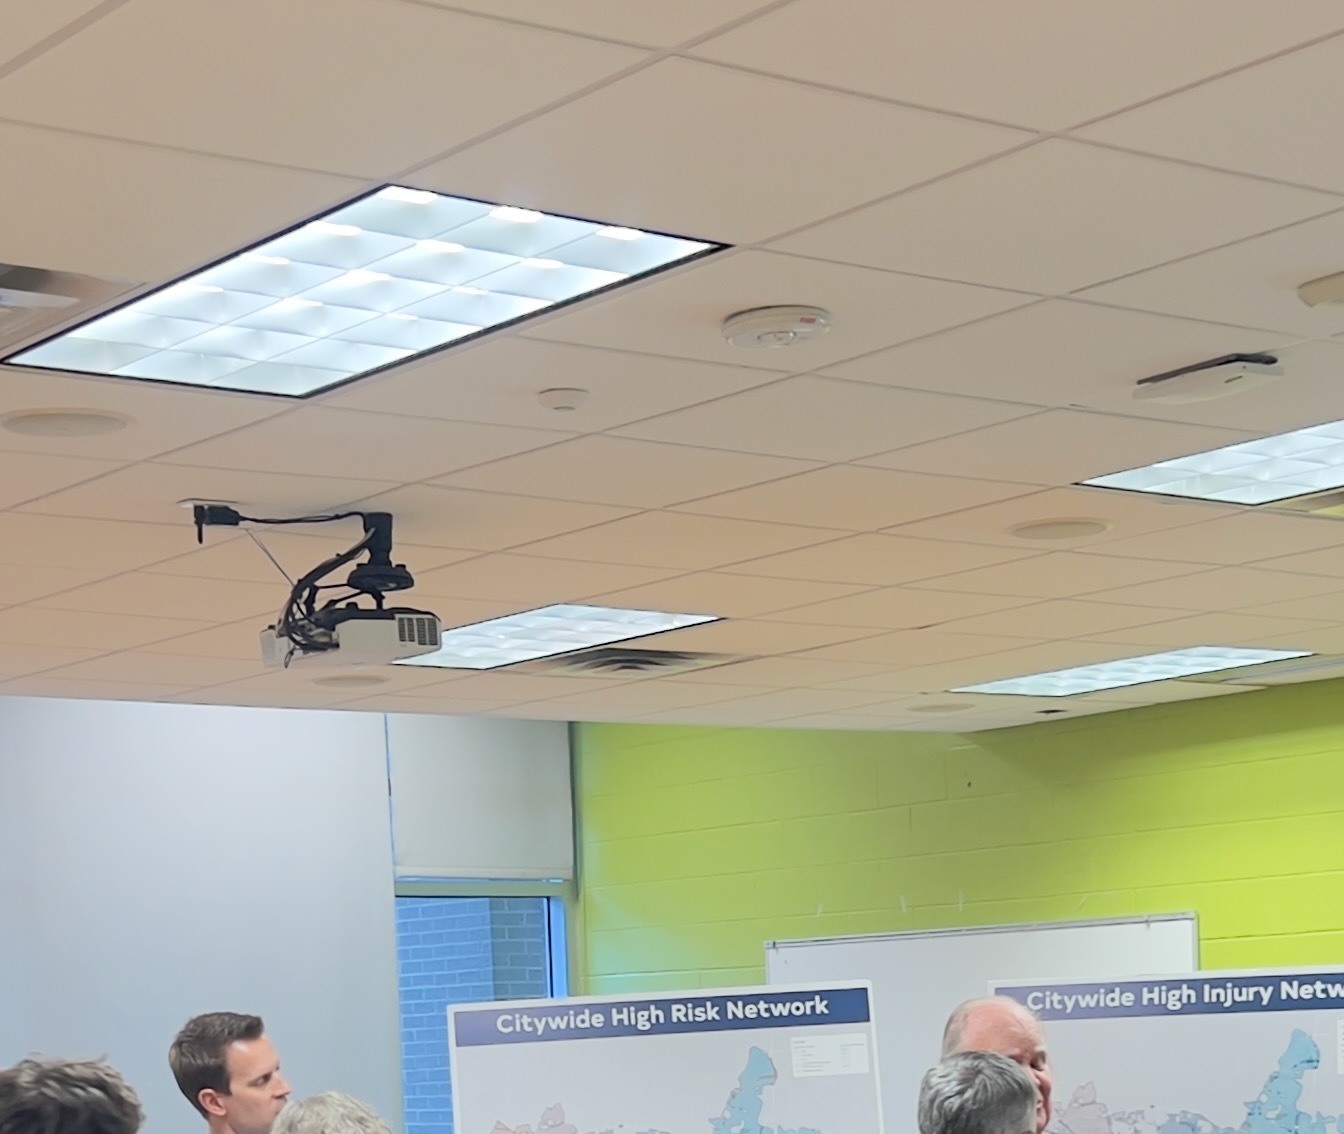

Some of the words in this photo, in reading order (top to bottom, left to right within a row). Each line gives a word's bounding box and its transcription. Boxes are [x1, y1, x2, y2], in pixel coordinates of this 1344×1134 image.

[496, 1009, 605, 1036] Citywide
[611, 1004, 665, 1032] High
[670, 1000, 721, 1024] Risk
[726, 995, 830, 1020] Network
[1027, 986, 1136, 1014] Citywide
[1142, 984, 1197, 1012] High
[1202, 981, 1274, 1009] Injury
